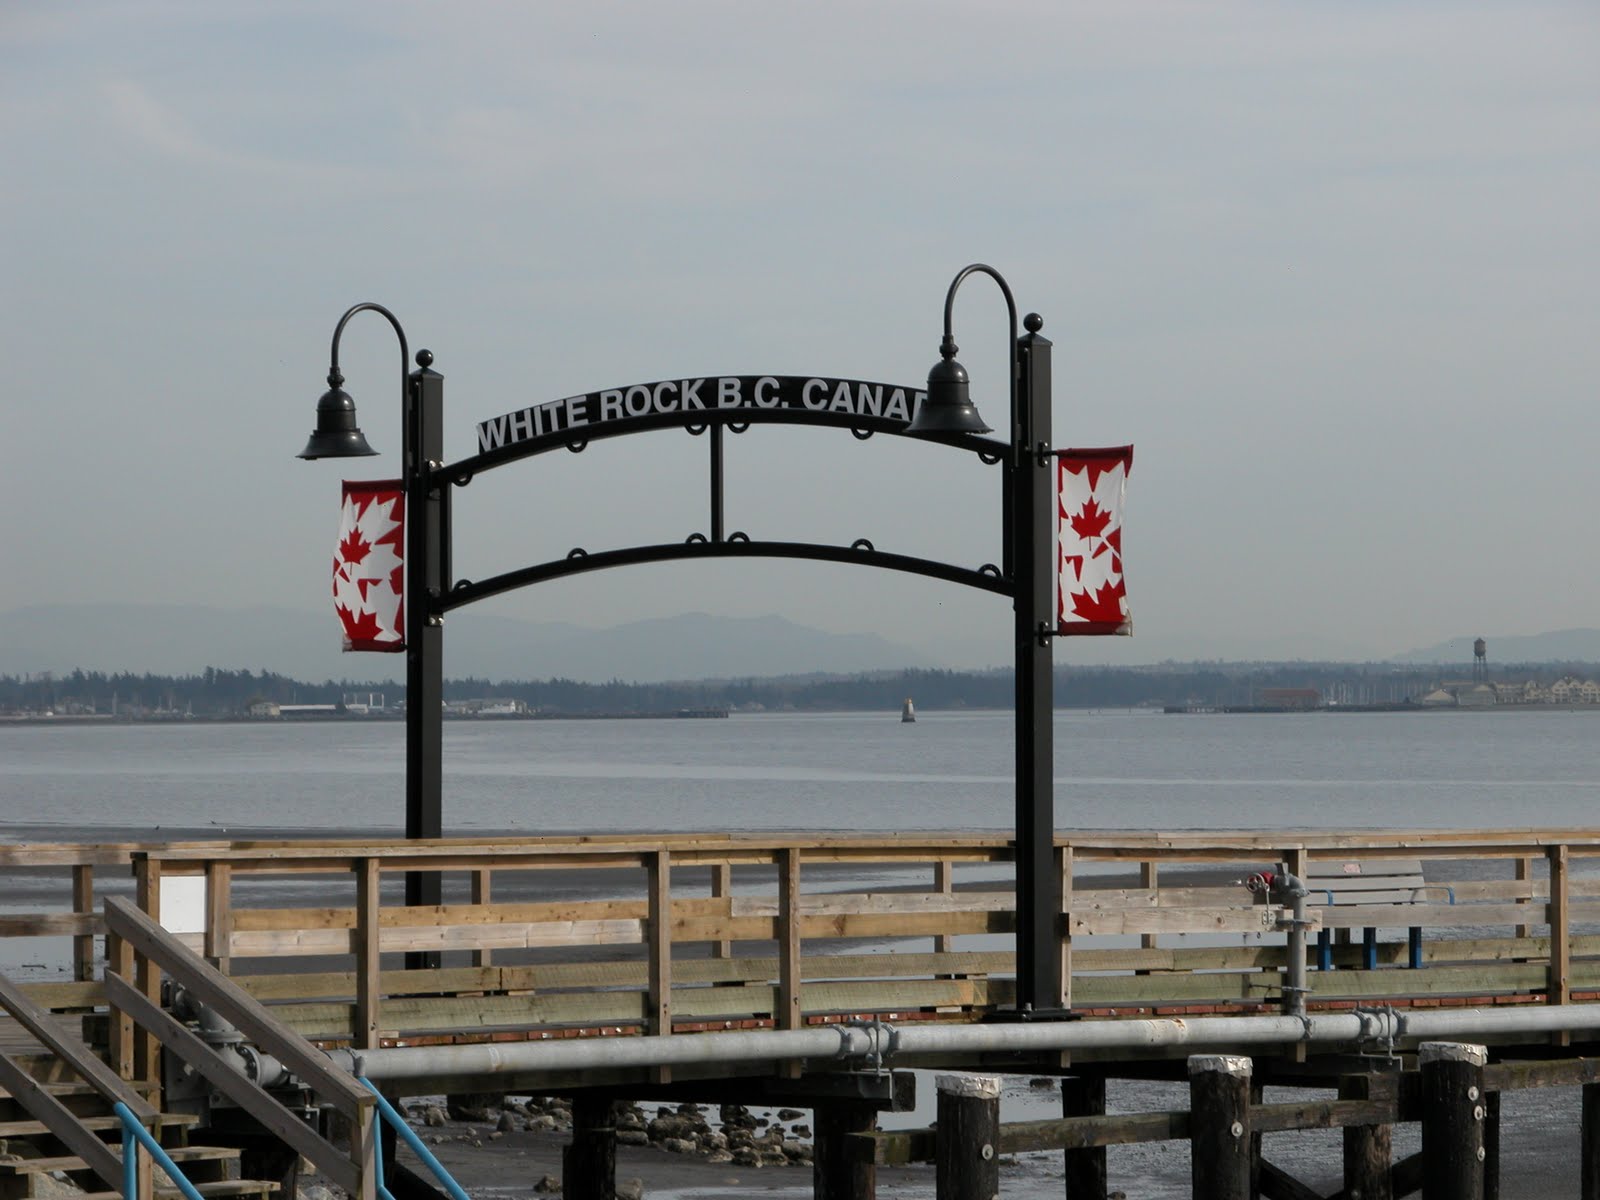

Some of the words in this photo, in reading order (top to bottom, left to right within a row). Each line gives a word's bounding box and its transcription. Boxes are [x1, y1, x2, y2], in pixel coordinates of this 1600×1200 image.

[475, 395, 590, 453] WHITE
[599, 378, 706, 422] ROCK
[717, 376, 789, 409] B.C.
